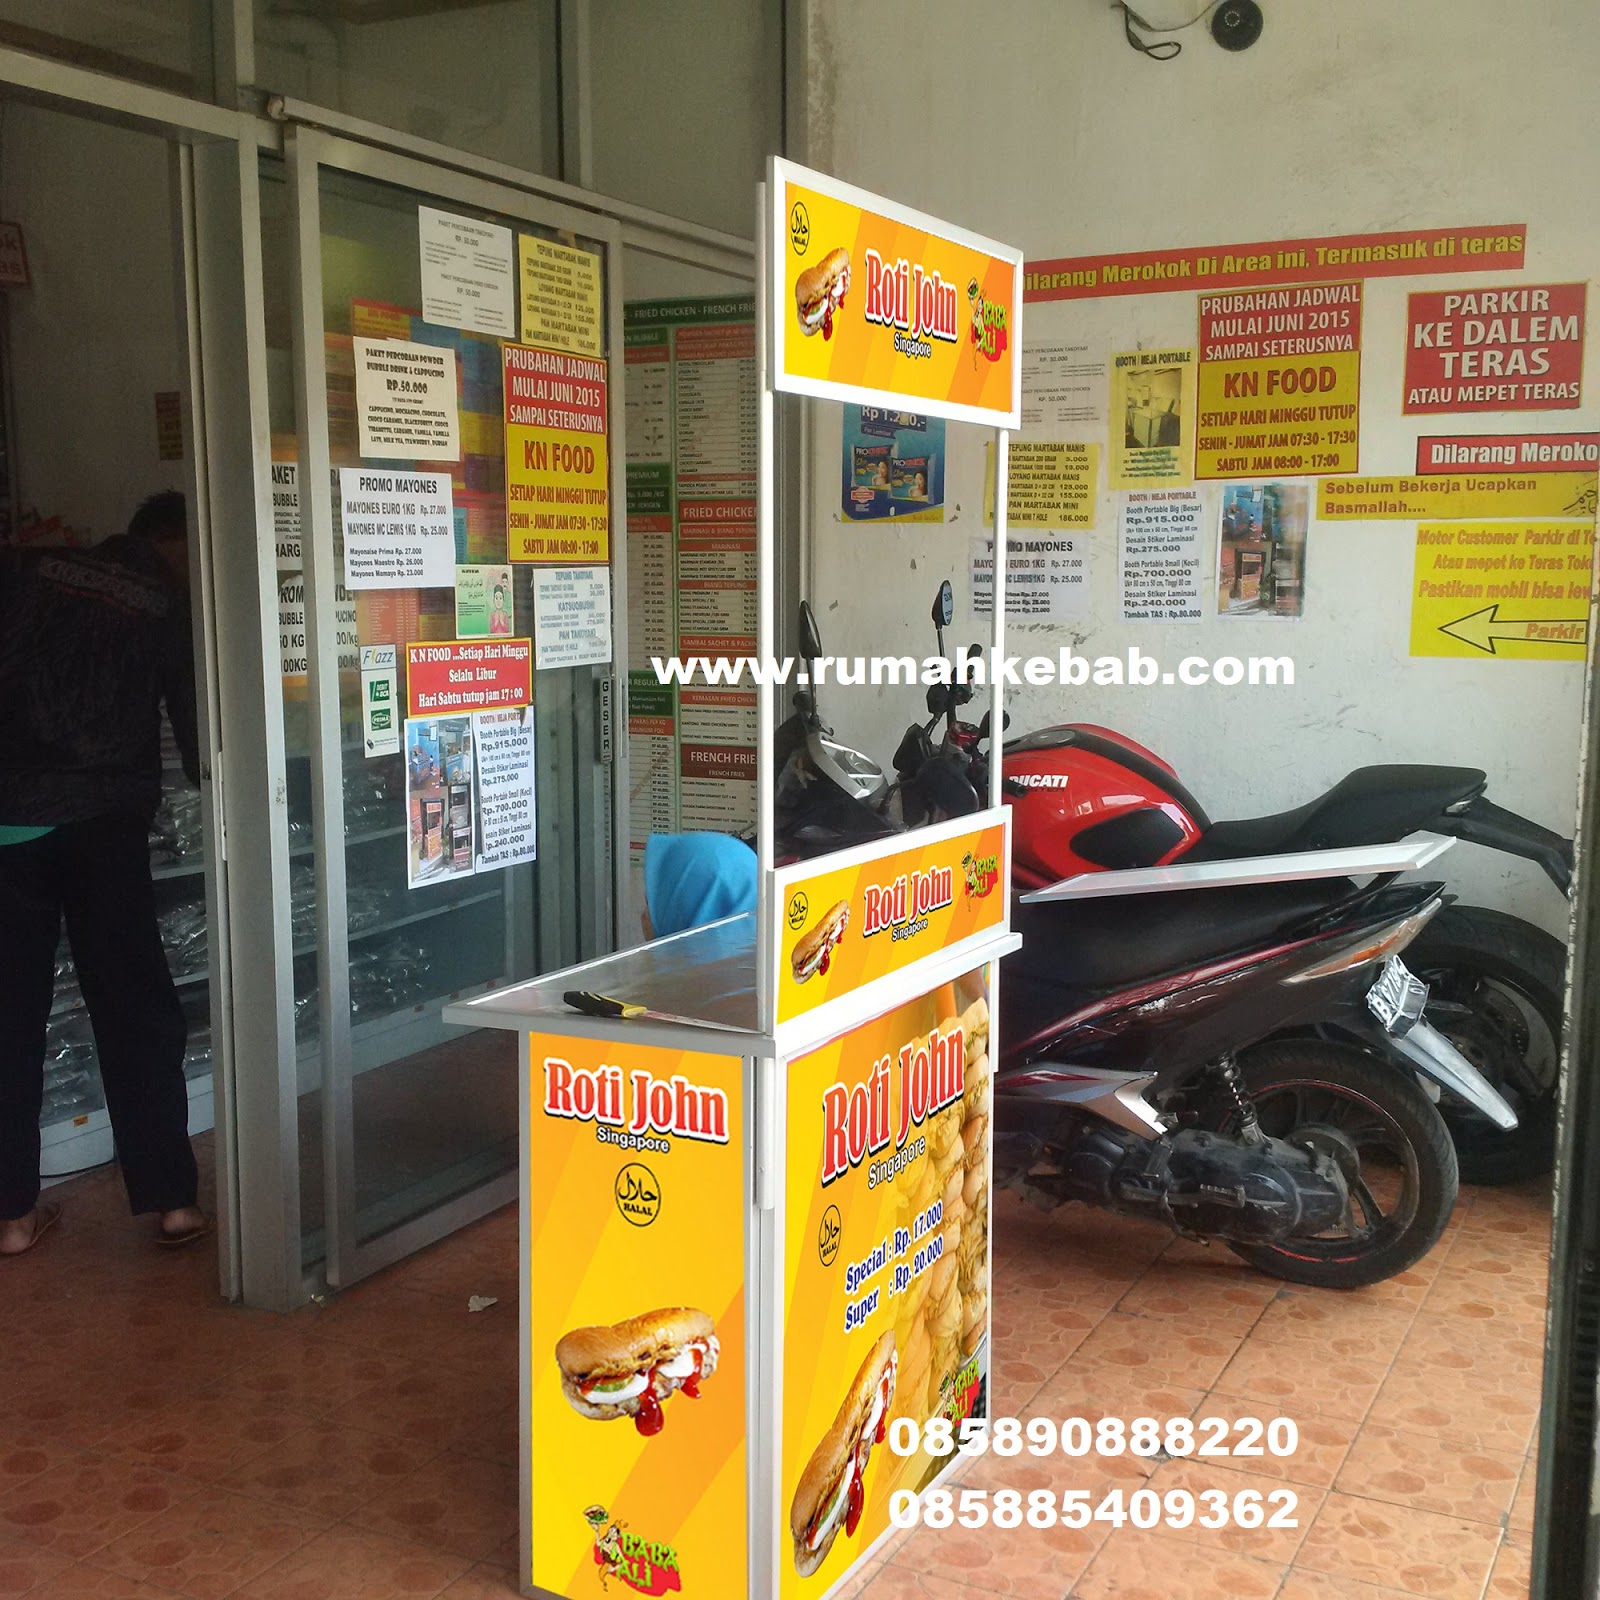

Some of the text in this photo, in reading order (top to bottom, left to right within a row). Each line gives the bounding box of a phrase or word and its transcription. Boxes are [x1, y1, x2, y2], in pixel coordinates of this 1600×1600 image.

[1024, 270, 1097, 291] ilarang
[1102, 259, 1191, 283] Merokok
[1197, 257, 1218, 276] Di
[1221, 254, 1271, 273] Area
[1316, 239, 1428, 266] Termasuk
[1433, 237, 1455, 256] di
[1461, 235, 1522, 254] teras
[865, 248, 957, 343] Roti John
[1201, 284, 1360, 316] PRUBAHAN JADWAL
[1444, 289, 1550, 317] PARKIR
[660, 306, 695, 317] CHICKEN
[1211, 310, 1350, 338] MULAI JUNI 2015
[1414, 315, 1579, 348] KE DALEM
[894, 333, 931, 359] Singapore
[1205, 334, 1353, 361] SAMPAI SETERUSNYA
[505, 347, 605, 383] PRUBAHAN JADWAL
[1158, 351, 1191, 364] PORTABLE
[1440, 348, 1550, 379] TERAS
[1224, 366, 1337, 398] KN FOOD
[512, 376, 600, 408] MULAI JUNI 2015
[1409, 382, 1580, 405] ATAU MEPET TERAS
[510, 405, 603, 433] SAMPAI SETERUSNYA
[862, 405, 879, 422] Rp
[1201, 404, 1356, 427] SETIAP HARI MINGGU TUTUP
[1199, 429, 1356, 450] SENIN JUMAT JAM 07:30 17:30
[524, 440, 595, 474] KN FOOD
[1217, 453, 1339, 472] SABTU JAM 08:00 17:00
[1431, 441, 1599, 465] Dilarang Meroko
[360, 477, 437, 494] PROMO MAYONES
[1325, 478, 1537, 494] Sebelum Bekerja Ucapkan
[347, 501, 380, 514] MAYONES
[381, 502, 400, 515] EURO
[402, 503, 416, 515] 1KG
[430, 505, 446, 515] 27.000
[683, 505, 756, 518] FRIED CHICKE
[1058, 514, 1088, 522] 186.000
[1126, 514, 1194, 525] Rp.915.000
[347, 523, 375, 535] MAYONES
[387, 523, 404, 536] LEWIS
[405, 524, 416, 535] 1KG
[430, 526, 448, 536] 25.000
[1125, 534, 1195, 544] Desain Stiker Laminasi
[1417, 529, 1454, 545] Motor
[1457, 529, 1518, 545] Customer
[1524, 529, 1563, 544] Parkir
[1025, 541, 1073, 552] MAYONES
[1126, 545, 1181, 554] Rp.275.000
[1141, 560, 1164, 568] Portable
[1165, 559, 1180, 567] Small
[1433, 554, 1463, 569] Atau
[1466, 555, 1506, 572] mepet
[1509, 555, 1525, 569] ke
[1529, 554, 1564, 569] Teras
[1124, 569, 1191, 579] Rp.700.000
[1419, 580, 1483, 598] Pastikan
[1486, 580, 1529, 598] mobil
[1532, 580, 1564, 598] bisa
[1124, 598, 1186, 608] Rp.240.000
[1168, 609, 1201, 618] Rp.80.000
[1525, 623, 1585, 640] Parkir
[410, 649, 418, 663] K
[418, 649, 426, 663] N
[427, 647, 451, 663] FOOD
[484, 645, 500, 658] Hari
[502, 645, 528, 660] Minggu
[449, 667, 497, 682] Selalu Libur
[419, 690, 500, 708] Hari Sabtu tutup jam
[602, 681, 610, 749] GESER
[481, 737, 528, 752] Rp.915.000
[690, 751, 757, 765] FRENCH FRIE
[481, 773, 519, 786] Rp.275.000
[863, 865, 953, 938] Roti John
[891, 919, 928, 942] Singapore
[544, 1057, 729, 1144] Roti John
[822, 1025, 965, 1189] Roti John
[597, 1127, 671, 1153] Singapore
[868, 1136, 926, 1190] Singapore
[623, 1203, 652, 1216] HALAL
[845, 1199, 943, 1293] Special Rp. 17.000
[845, 1235, 944, 1333] Super Rp. 20.000
[621, 1532, 680, 1573] BABA
